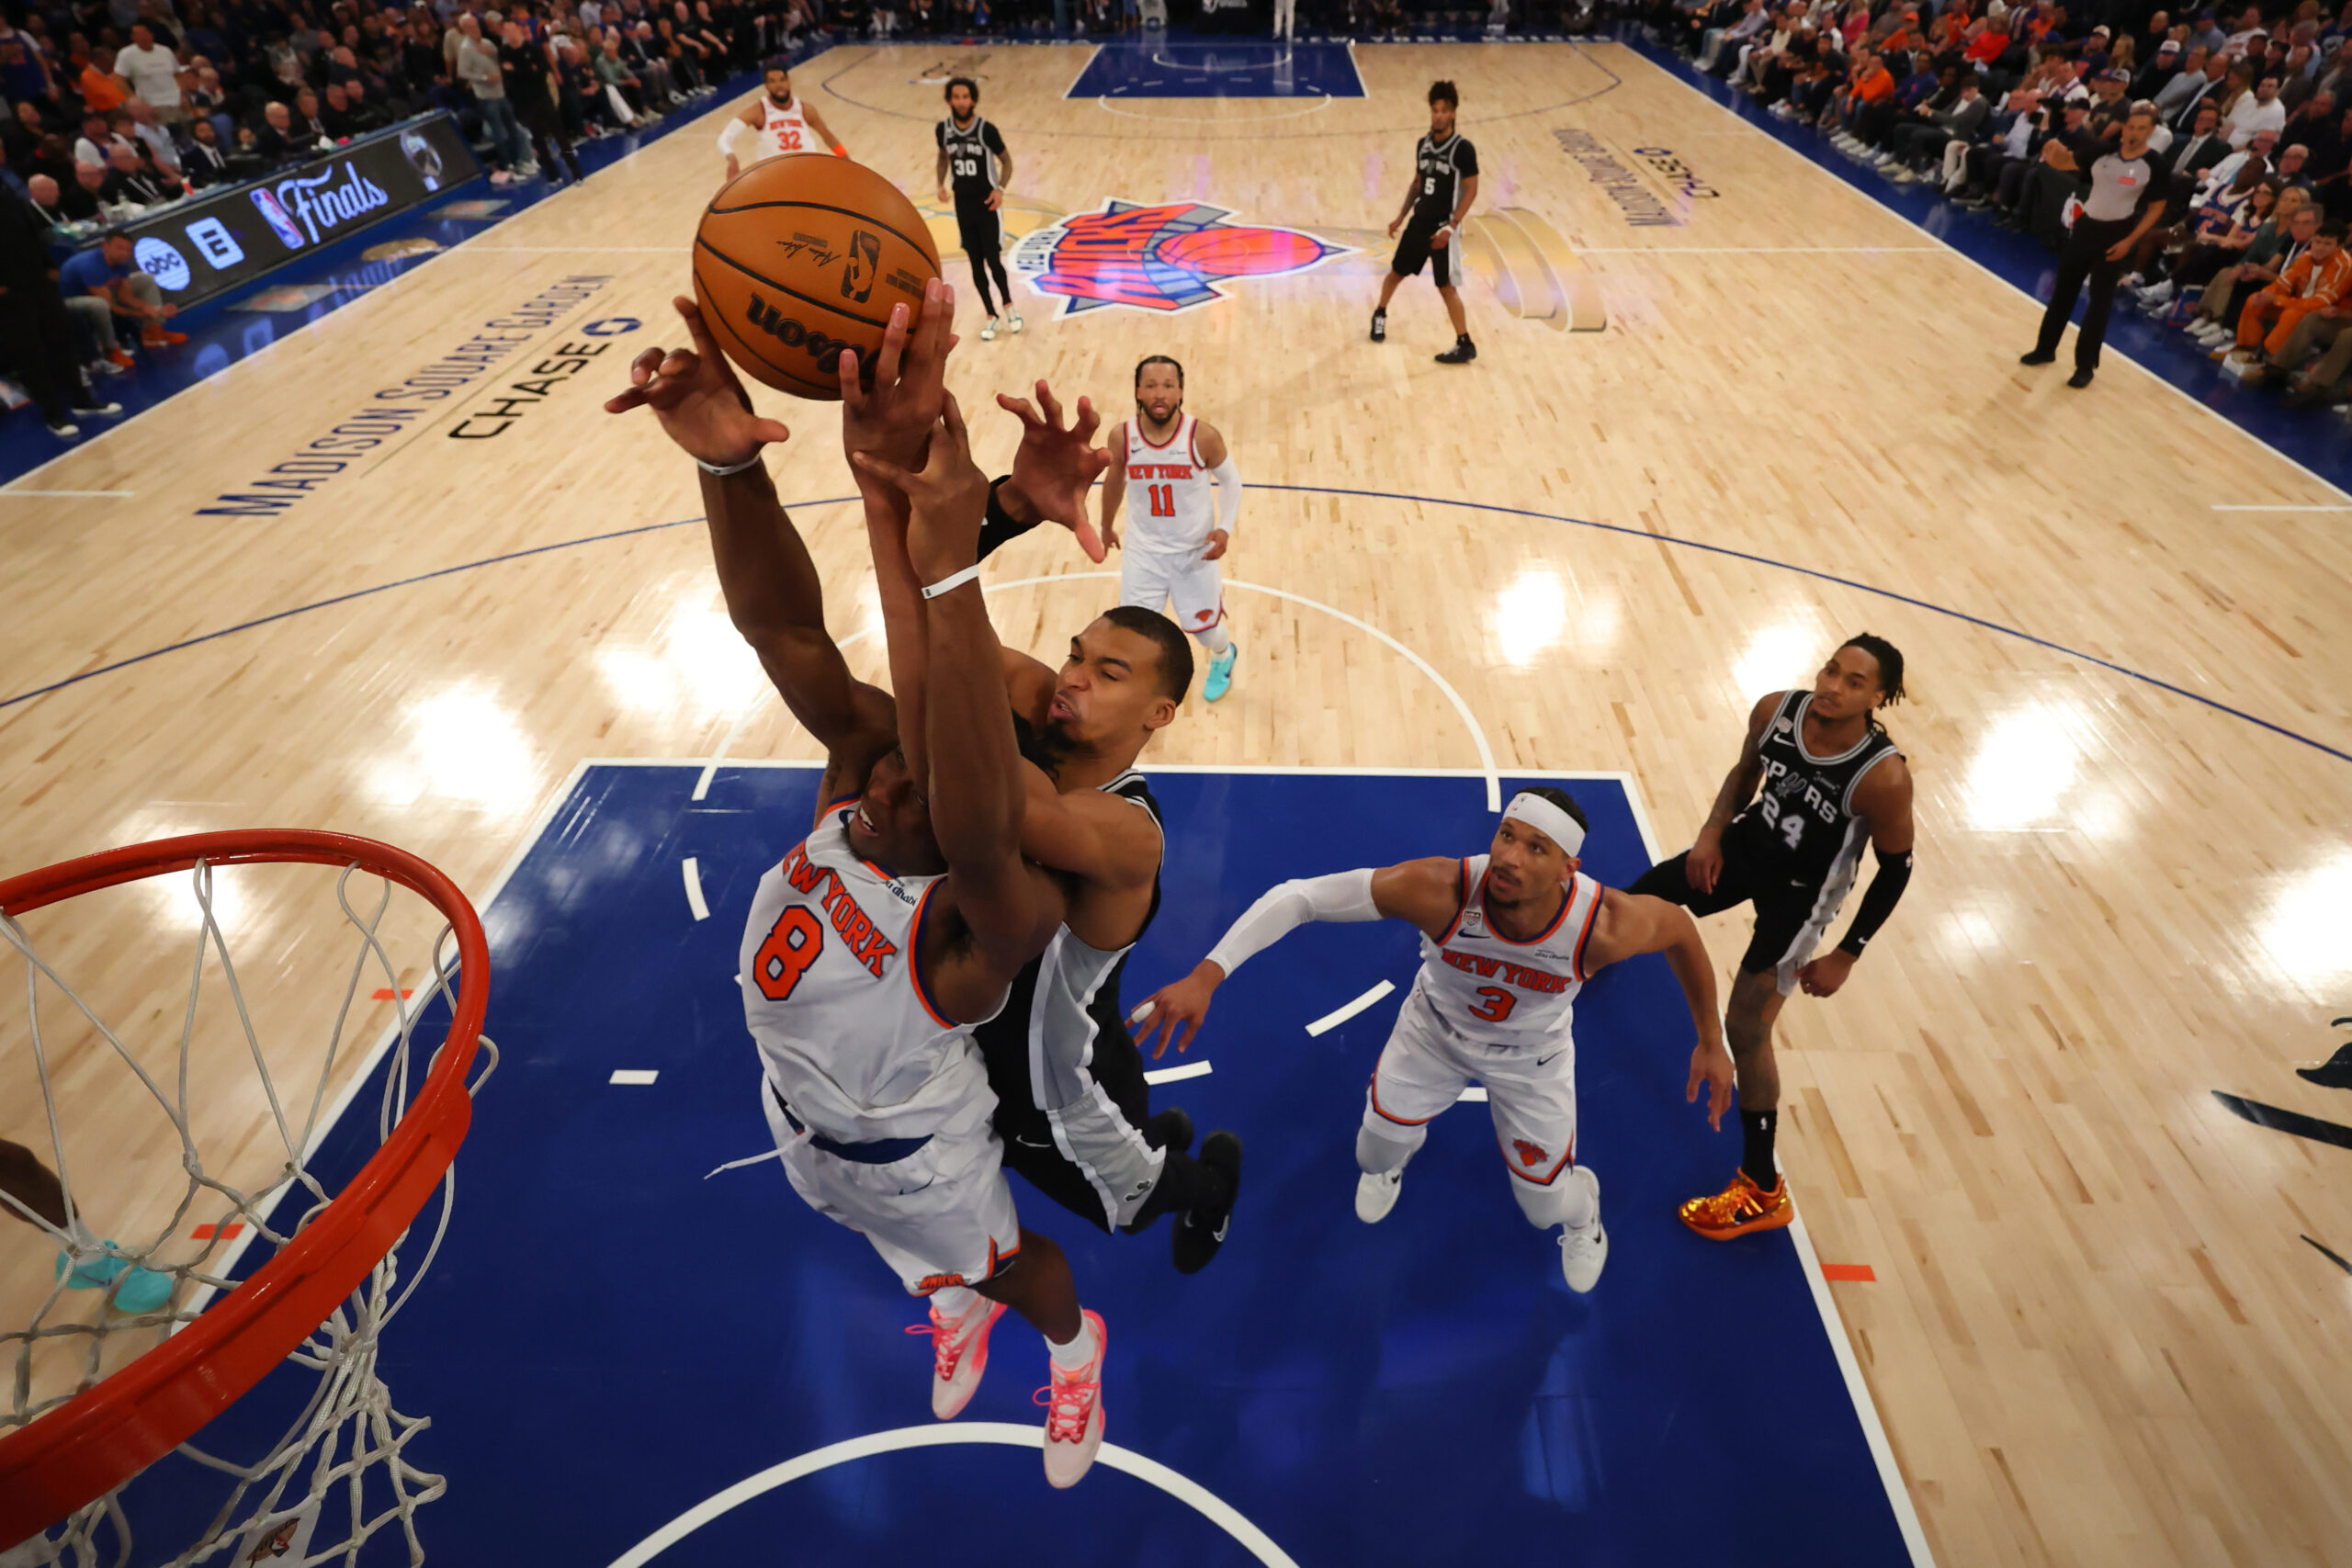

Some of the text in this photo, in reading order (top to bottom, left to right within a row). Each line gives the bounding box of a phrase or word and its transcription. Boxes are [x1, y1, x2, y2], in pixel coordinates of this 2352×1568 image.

[777, 130, 802, 151] 32
[954, 159, 978, 176] 30
[1424, 177, 1435, 195] 5
[144, 253, 181, 275] abc
[277, 161, 389, 244] Finals
[1034, 204, 1197, 310] KNICKS
[448, 342, 613, 439] CHASE
[193, 408, 425, 515] MADISON
[374, 333, 532, 400] SQUARE
[1127, 464, 1193, 479] NEW YORK
[1148, 484, 1175, 516] 11
[1761, 791, 1804, 850] 24
[821, 869, 898, 979] YORK
[753, 905, 824, 1001] 8
[1442, 948, 1572, 994] NEW YORK
[1468, 986, 1518, 1022] 3
